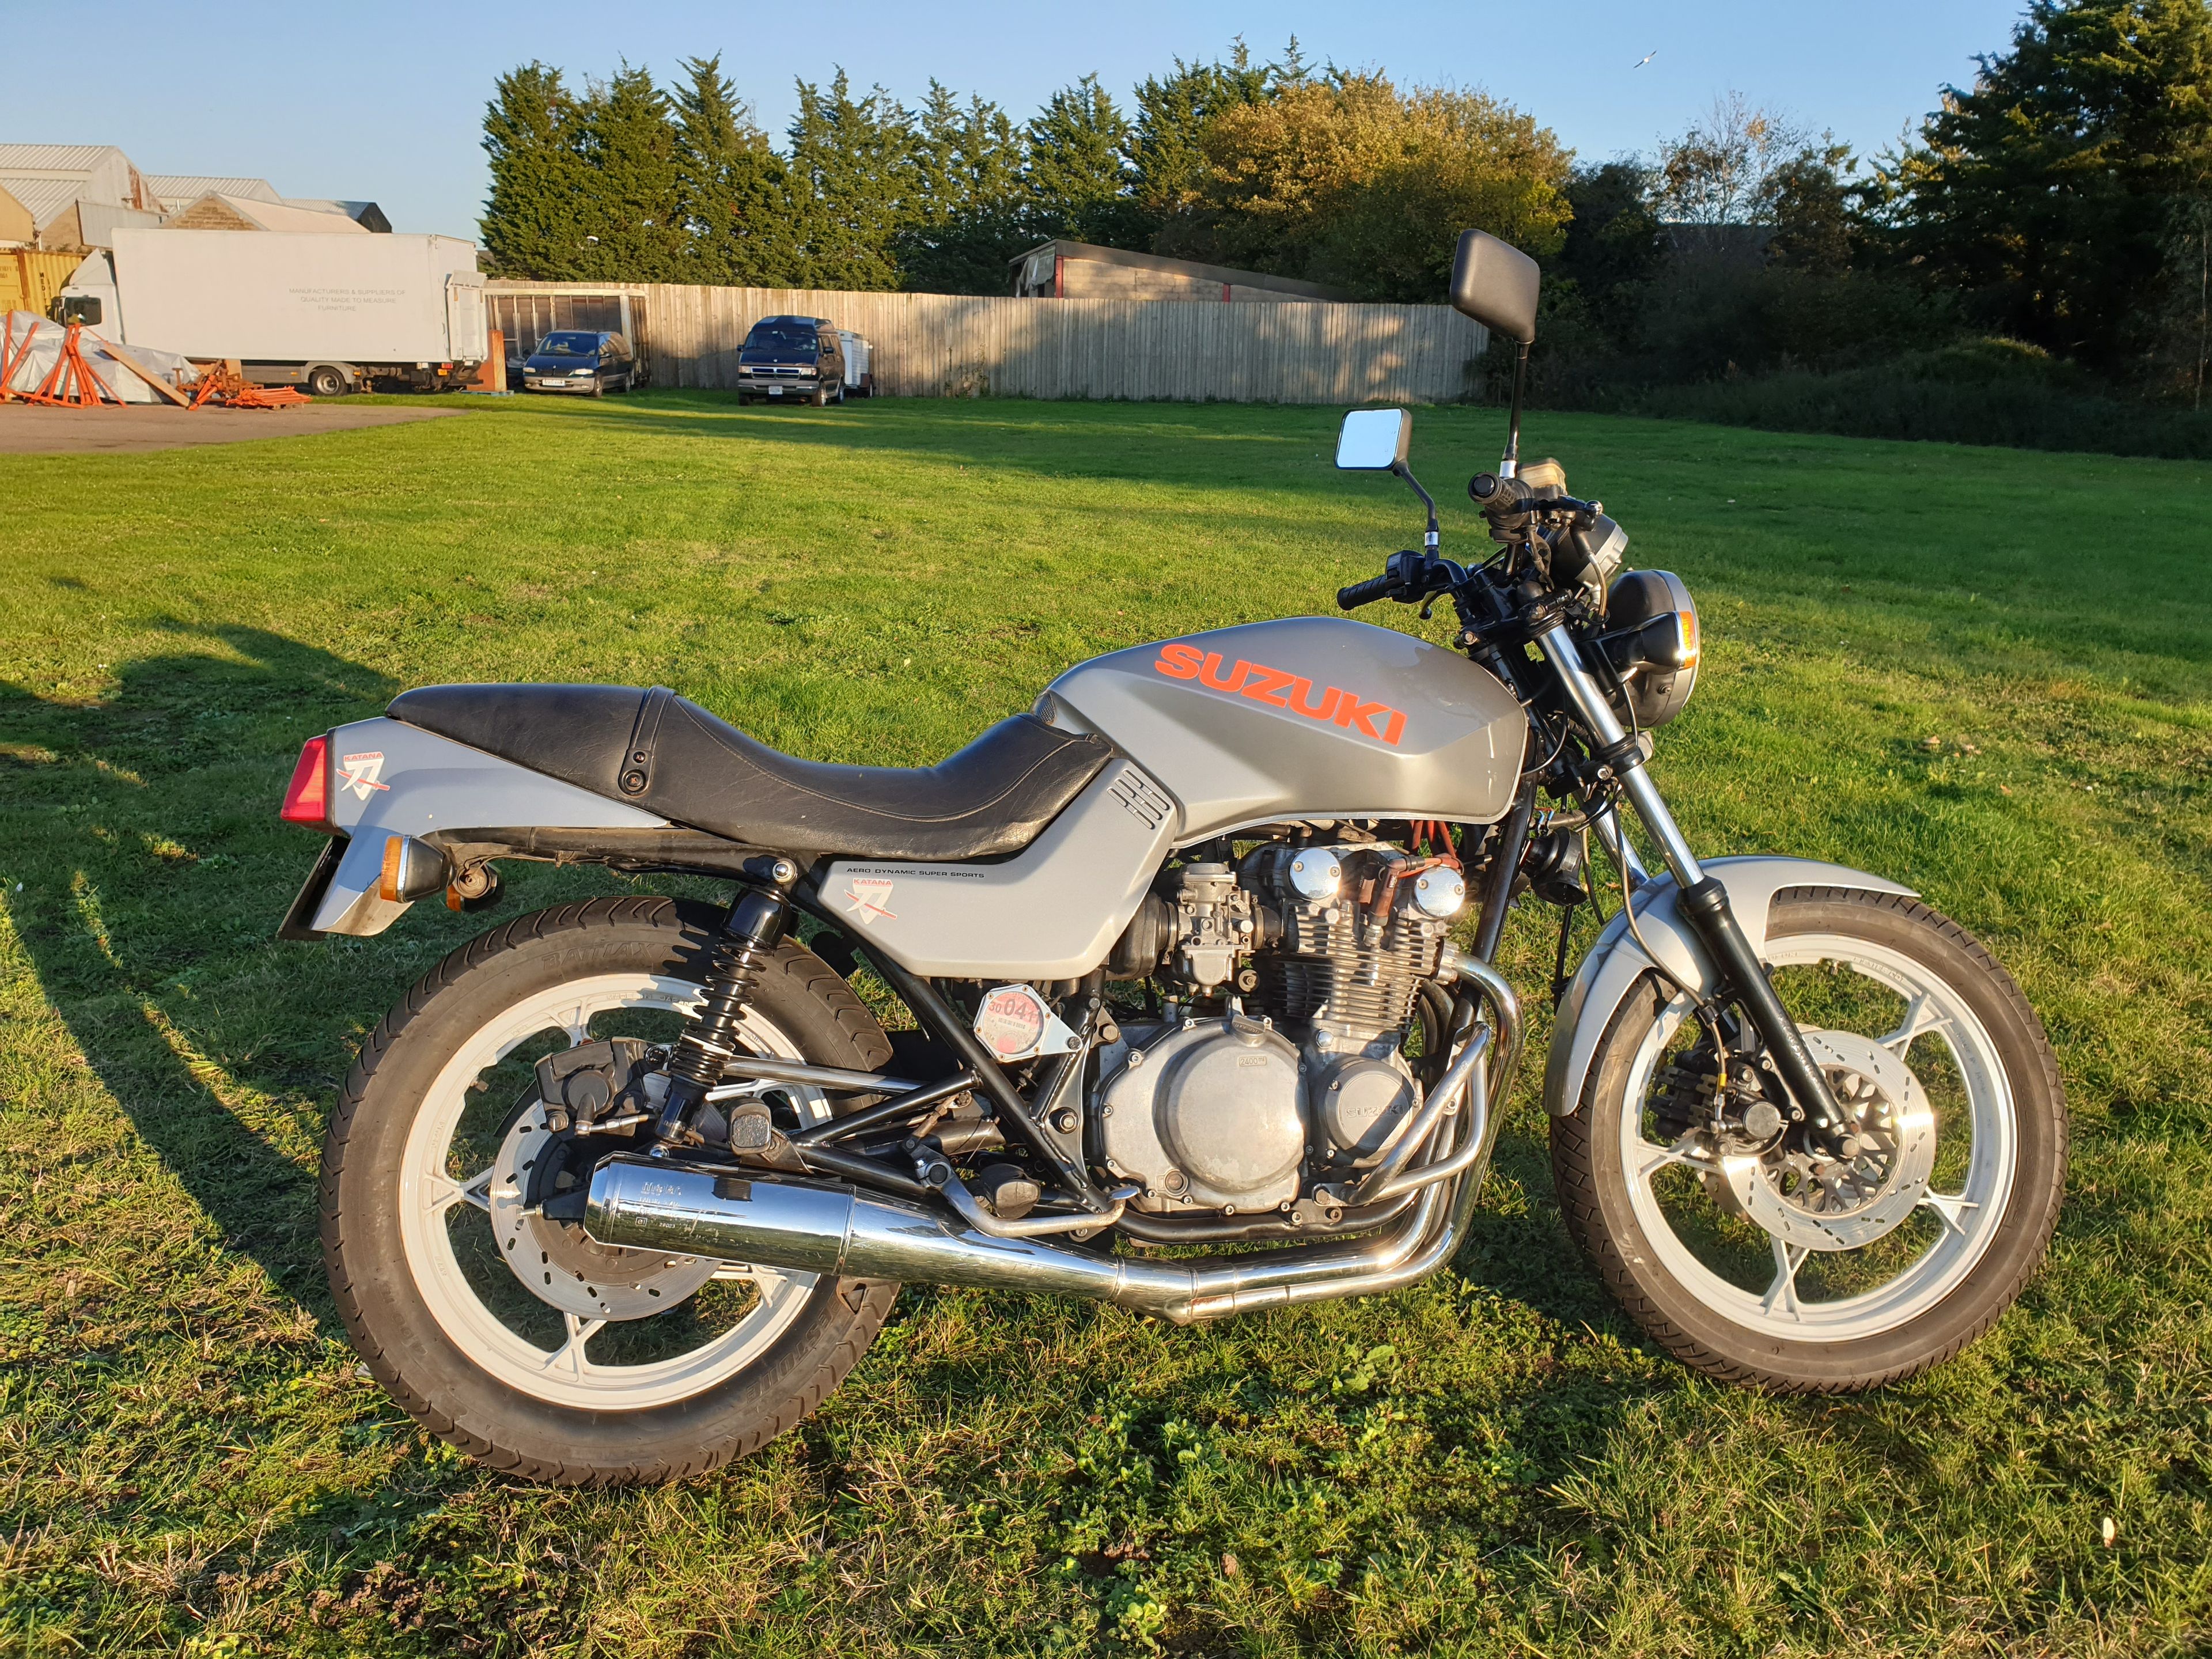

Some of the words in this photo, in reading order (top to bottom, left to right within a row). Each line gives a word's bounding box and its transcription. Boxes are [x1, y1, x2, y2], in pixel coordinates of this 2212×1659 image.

[1154, 644, 1407, 747] SUZUKI
[344, 752, 382, 761] KATANA
[988, 1002, 1002, 1013] 30
[1004, 998, 1027, 1020] 04
[1346, 1104, 1403, 1118] SUZUKI
